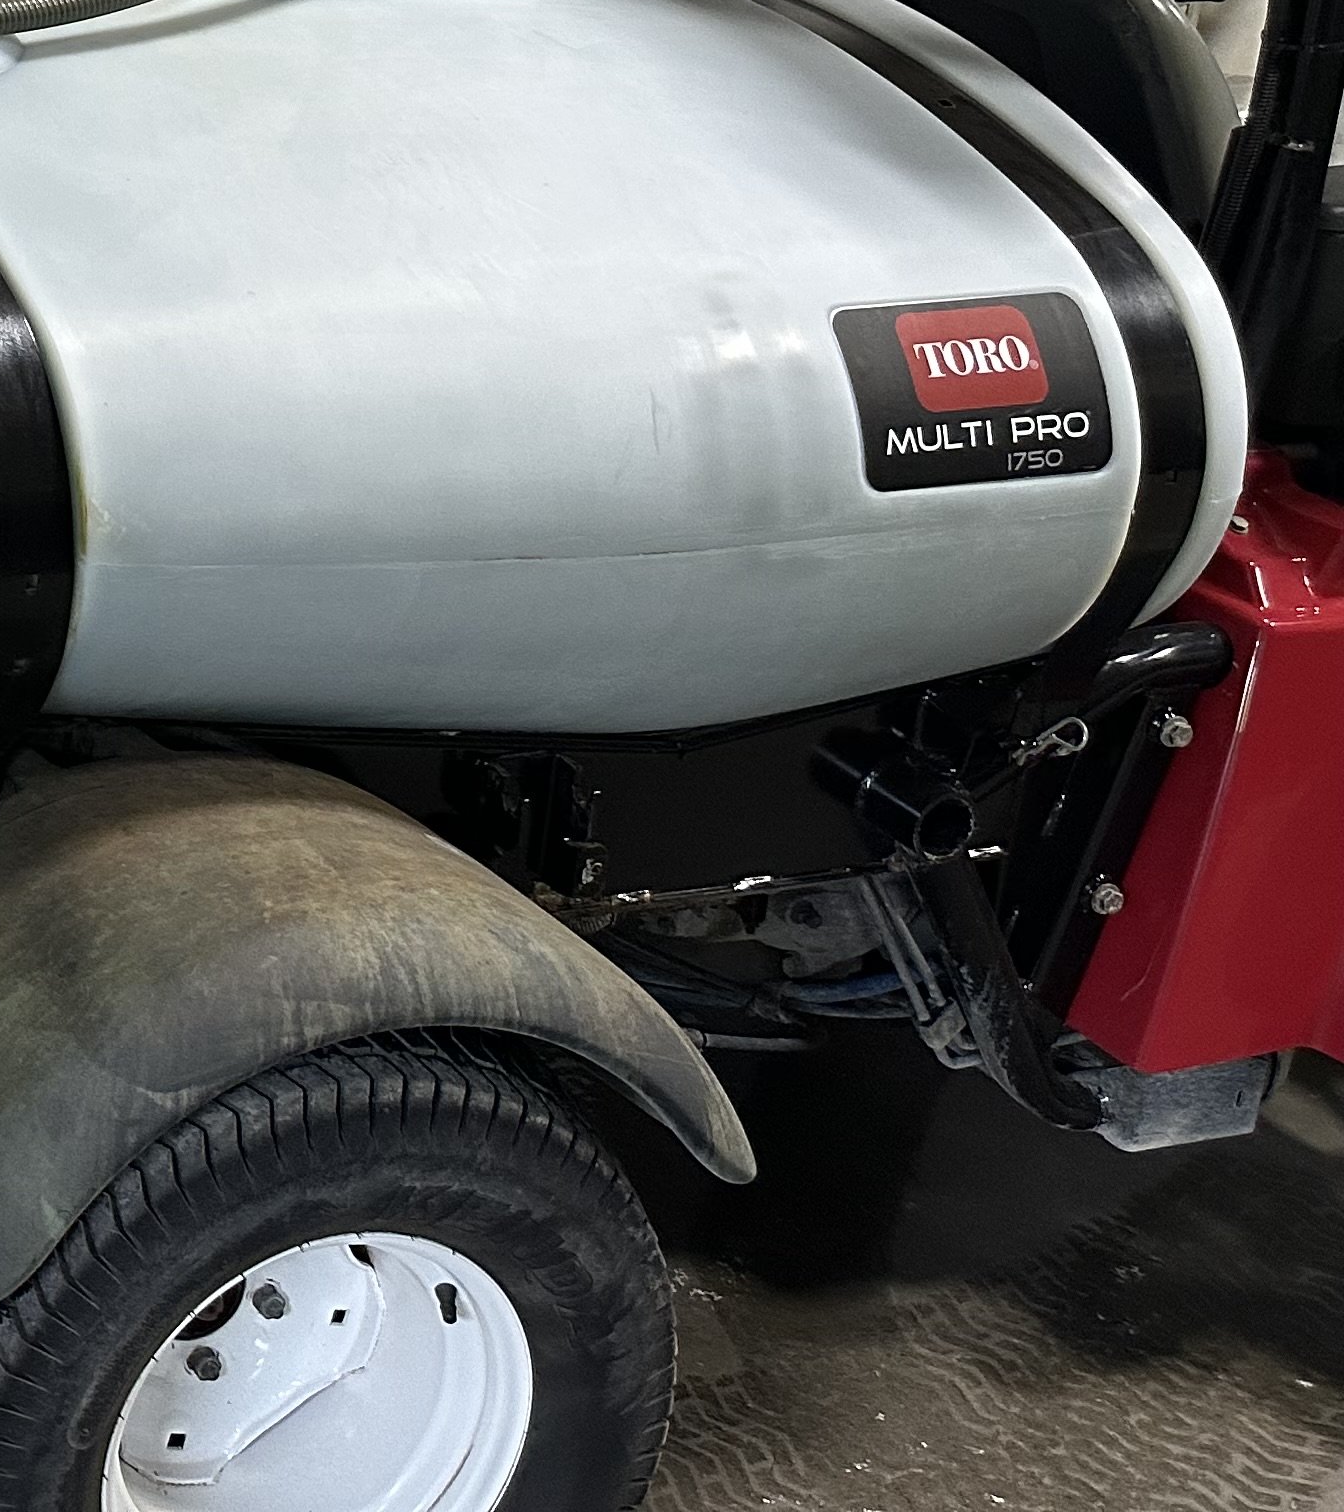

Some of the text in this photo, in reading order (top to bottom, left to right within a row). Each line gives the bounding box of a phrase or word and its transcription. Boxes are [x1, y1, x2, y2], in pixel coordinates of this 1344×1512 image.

[912, 335, 1030, 379] TORO
[886, 411, 1090, 456] MULTI PRO
[1007, 448, 1064, 472] 1750
